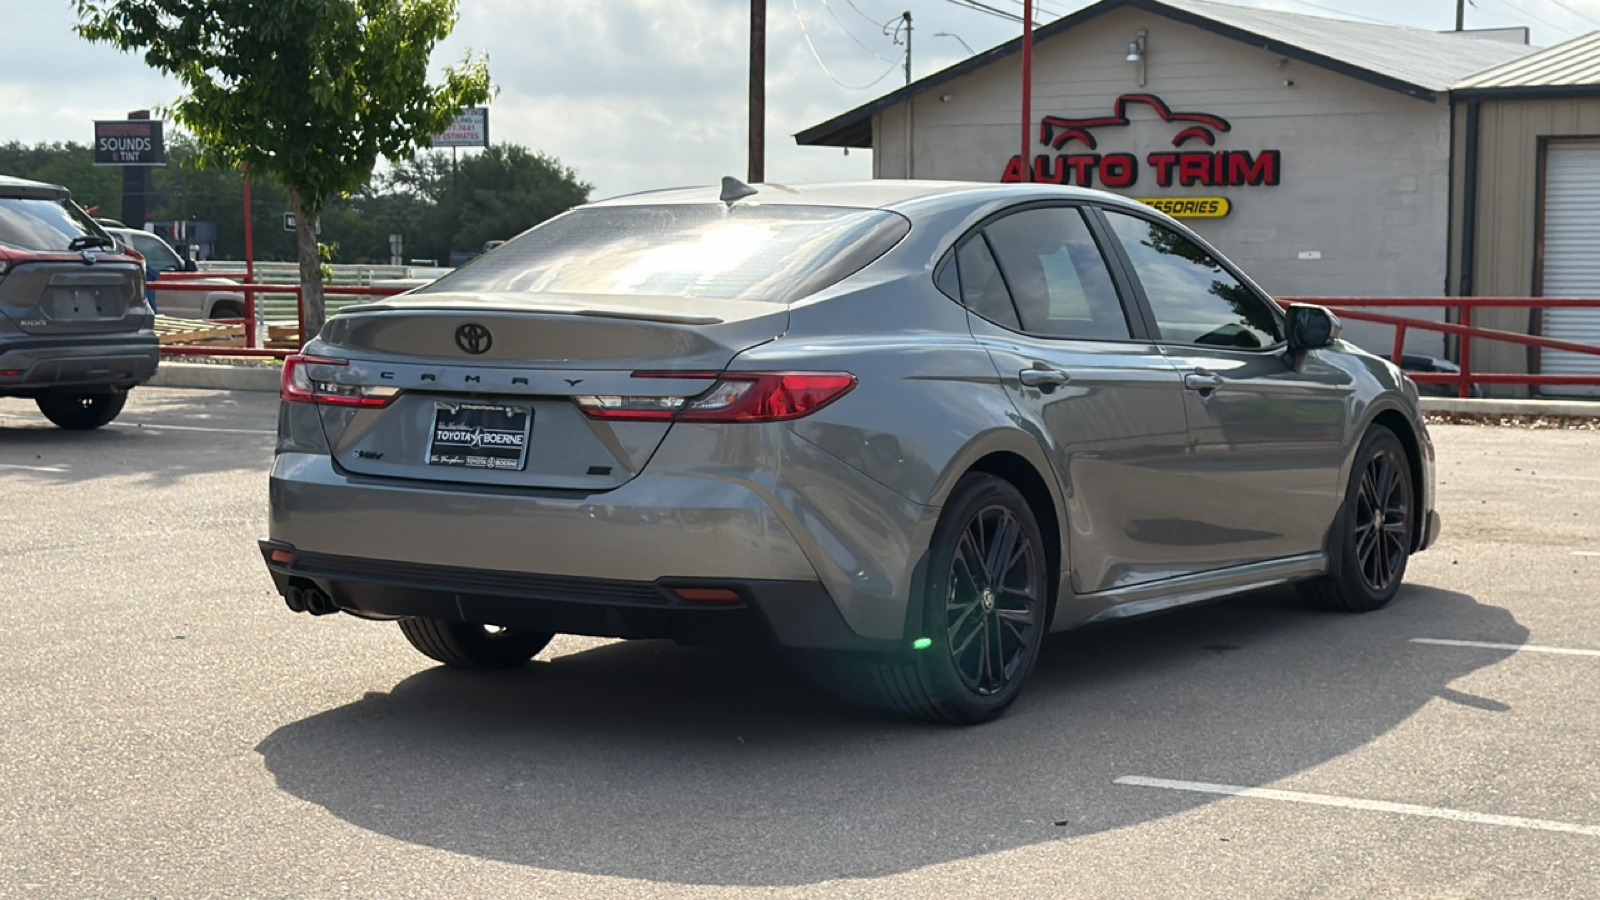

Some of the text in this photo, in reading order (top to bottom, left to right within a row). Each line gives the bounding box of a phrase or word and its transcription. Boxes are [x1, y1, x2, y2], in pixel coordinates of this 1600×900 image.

[100, 137, 152, 151] SOUNDS
[120, 152, 140, 161] TINT
[1000, 150, 1281, 188] AUTO TRIM
[380, 371, 585, 387] CAMRY
[436, 430, 525, 445] TOYOTA BOERNE
[466, 457, 487, 465] TOYOTA
